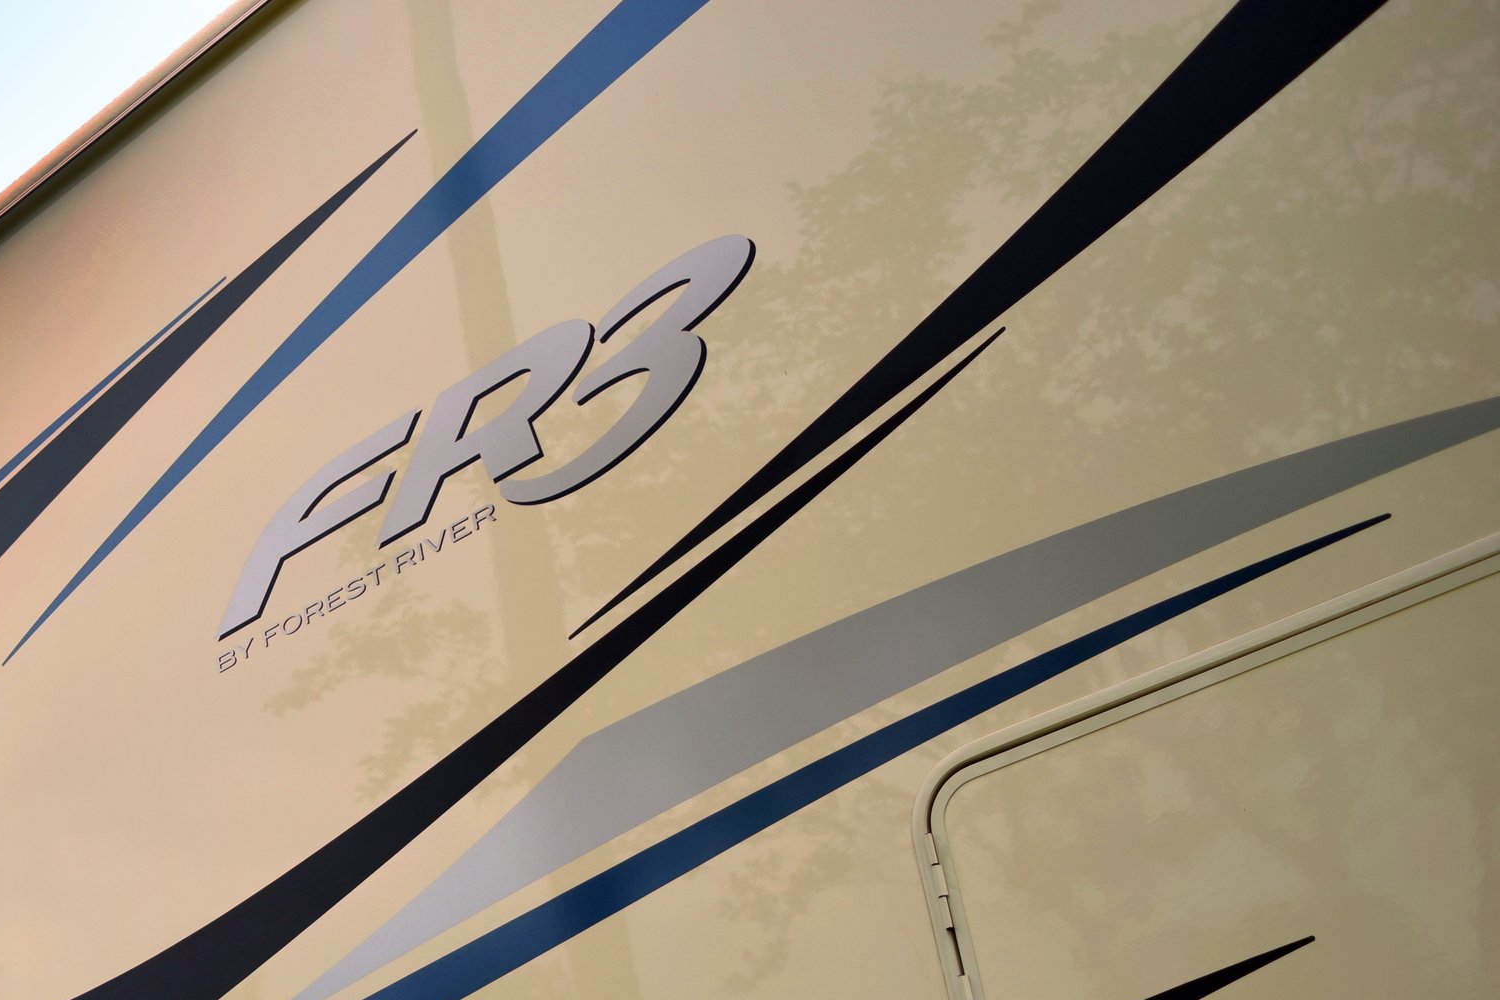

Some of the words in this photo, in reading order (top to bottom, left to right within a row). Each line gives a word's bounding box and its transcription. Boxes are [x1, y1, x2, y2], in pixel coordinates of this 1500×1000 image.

[216, 234, 756, 642] FR3
[218, 637, 254, 673] BY
[263, 564, 386, 649] FOREST
[394, 503, 498, 574] RIVER
